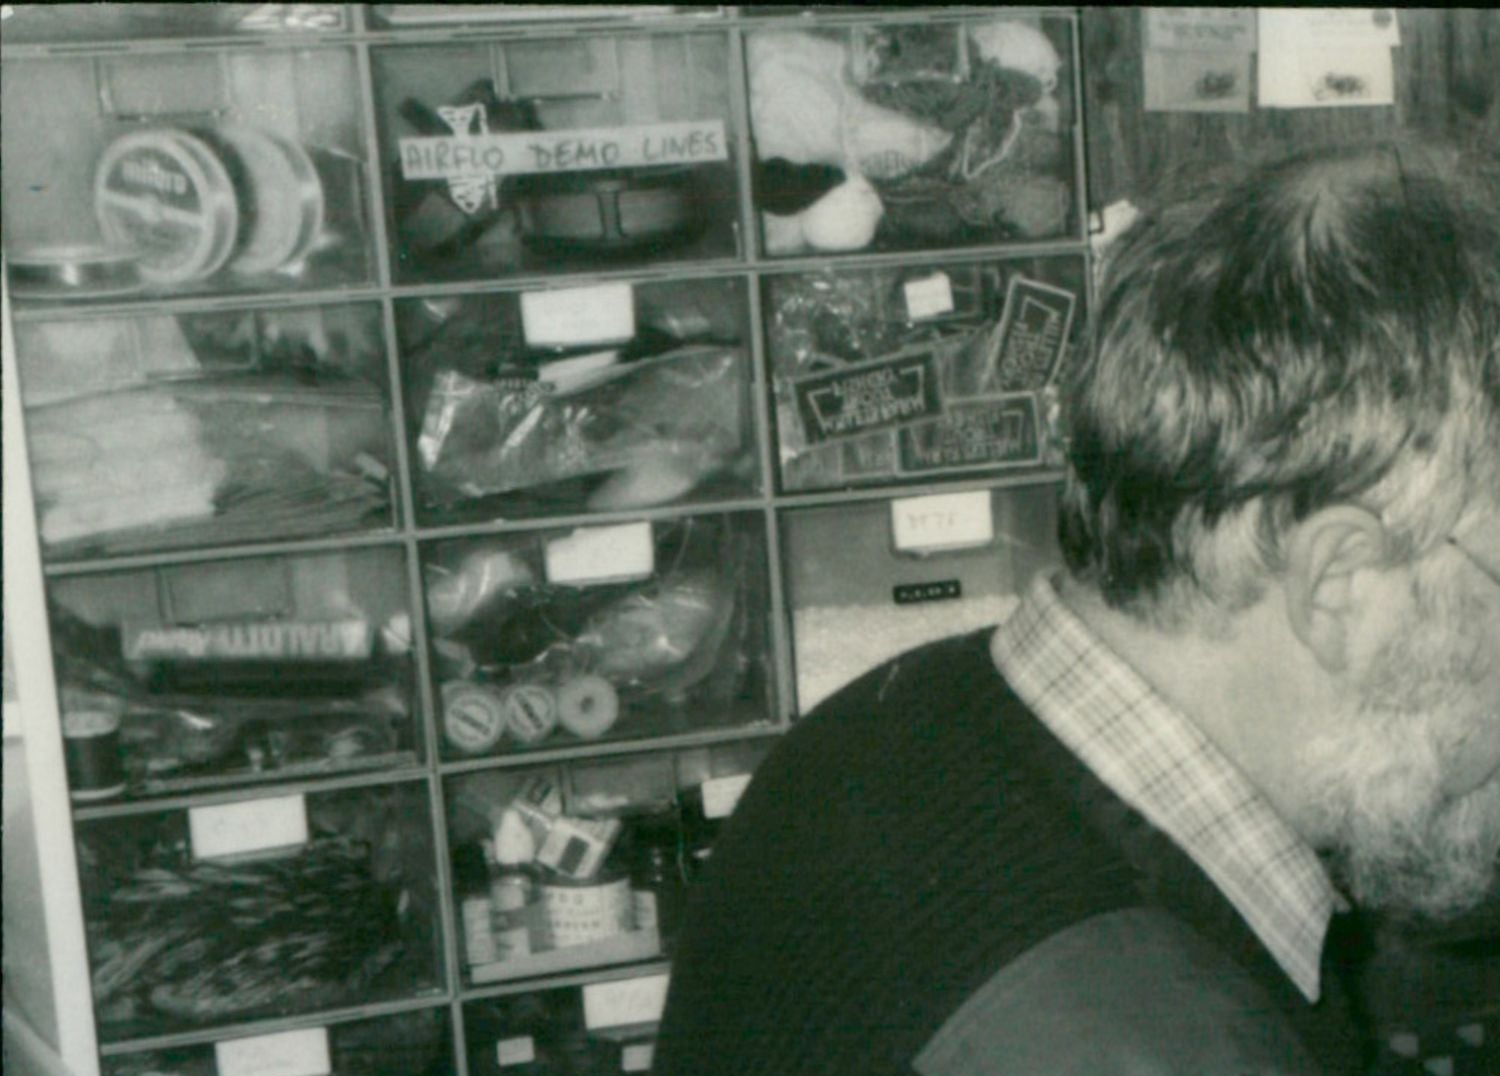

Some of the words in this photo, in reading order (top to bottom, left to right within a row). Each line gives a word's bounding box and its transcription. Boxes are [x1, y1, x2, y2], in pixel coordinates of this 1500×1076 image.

[405, 142, 505, 172] AIRFLO
[528, 142, 620, 168] DEMO
[642, 128, 719, 159] LINES
